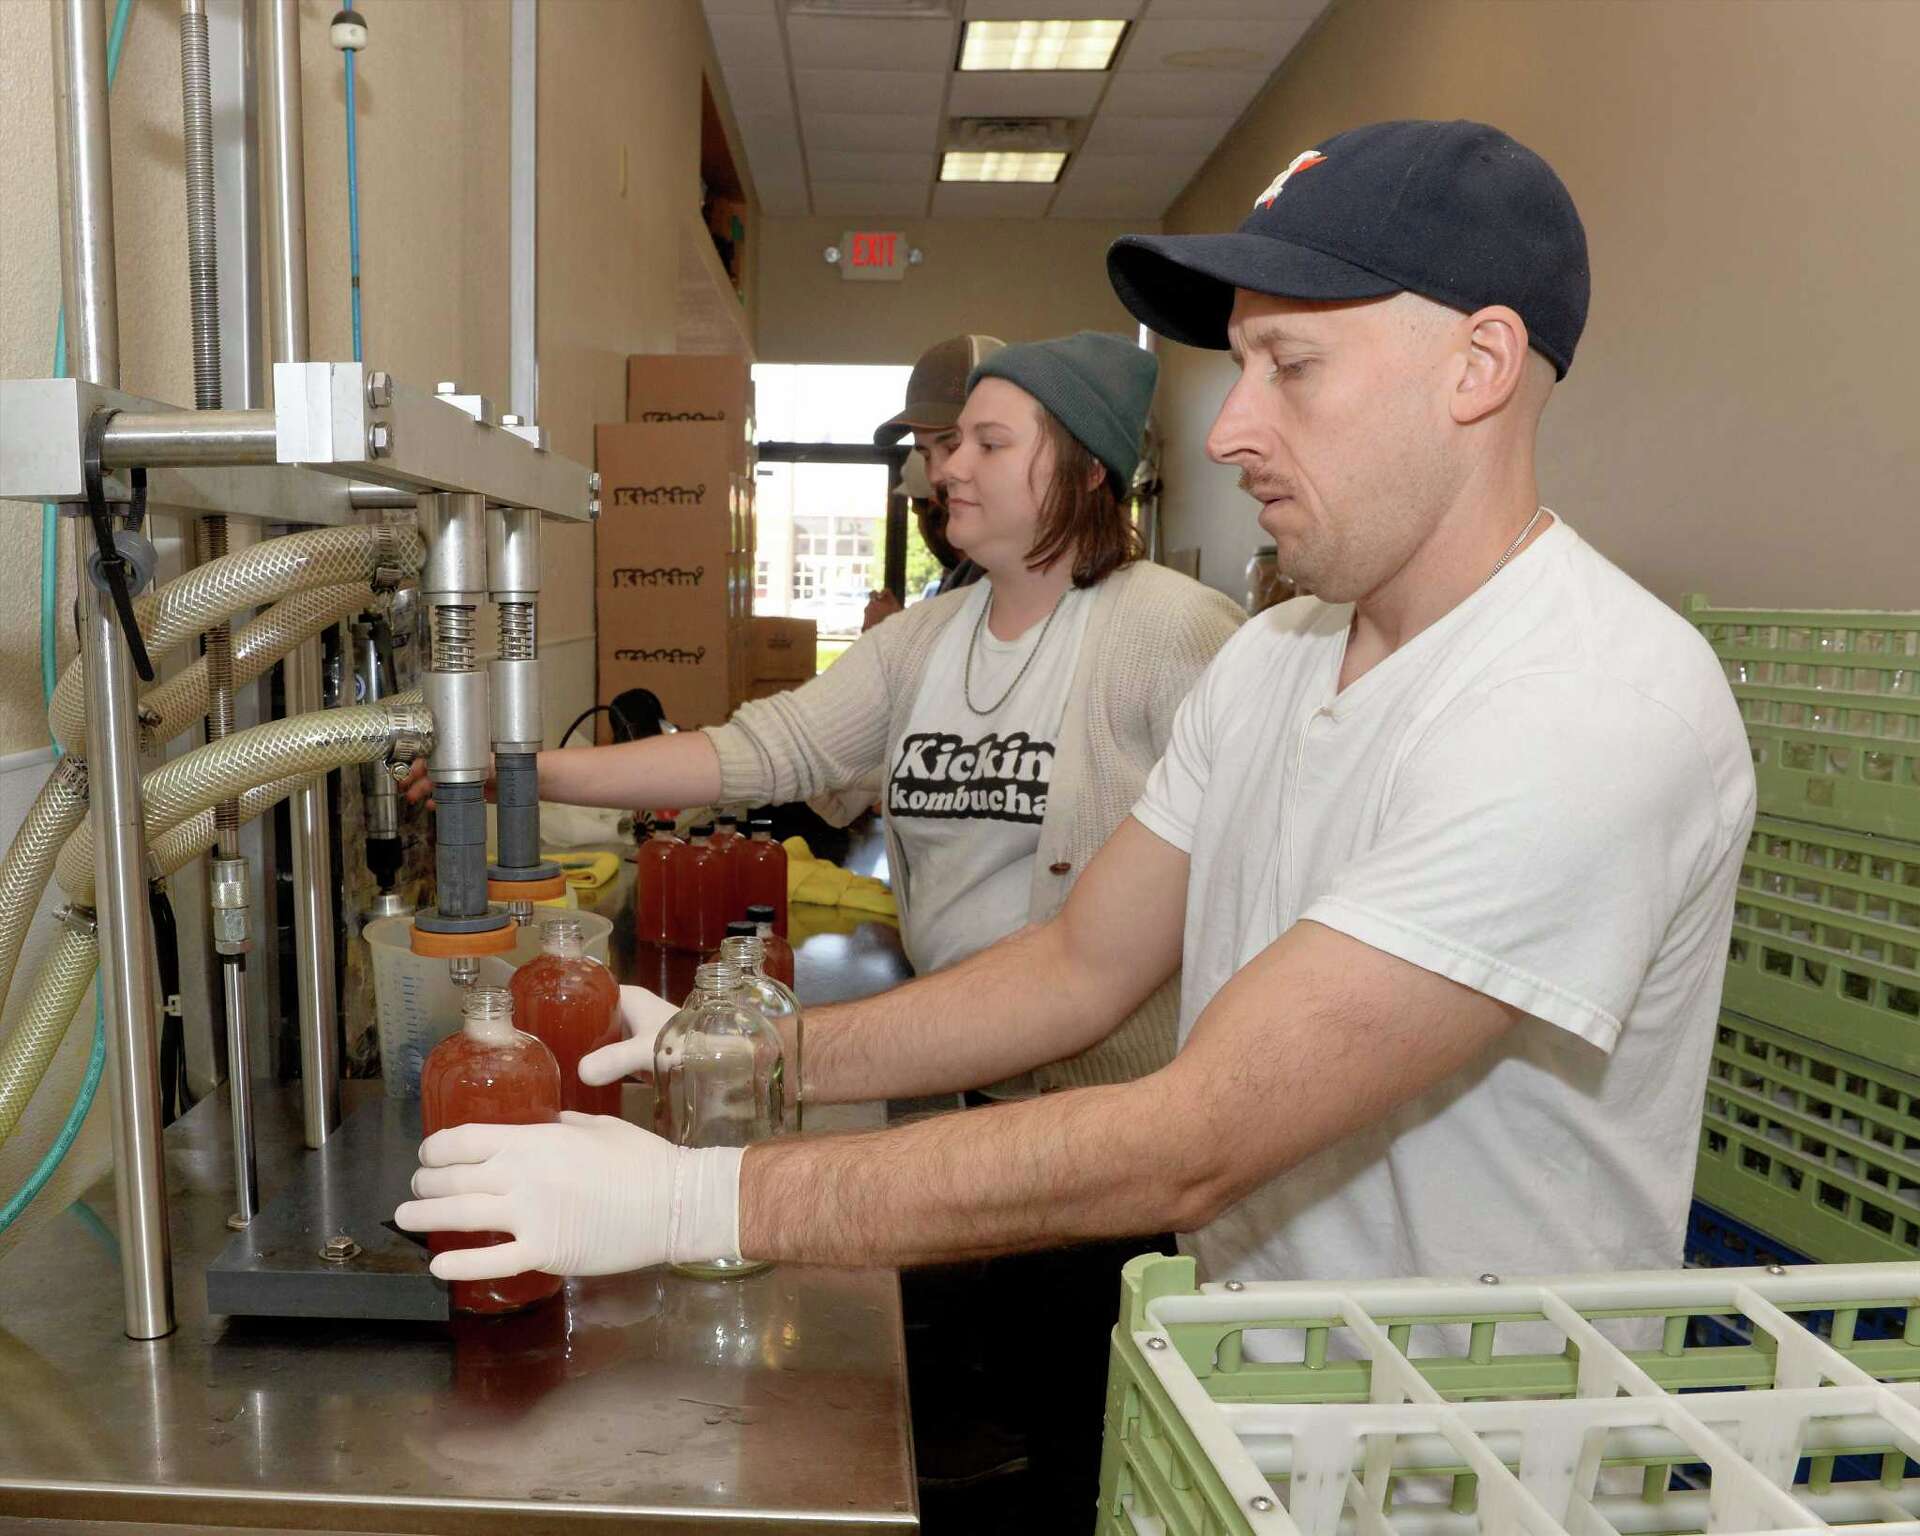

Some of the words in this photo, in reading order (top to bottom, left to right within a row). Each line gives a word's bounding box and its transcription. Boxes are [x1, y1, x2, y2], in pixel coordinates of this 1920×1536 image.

[852, 233, 897, 267] EXIT
[894, 736, 1053, 783] Kickin
[889, 782, 1048, 816] kombucha
